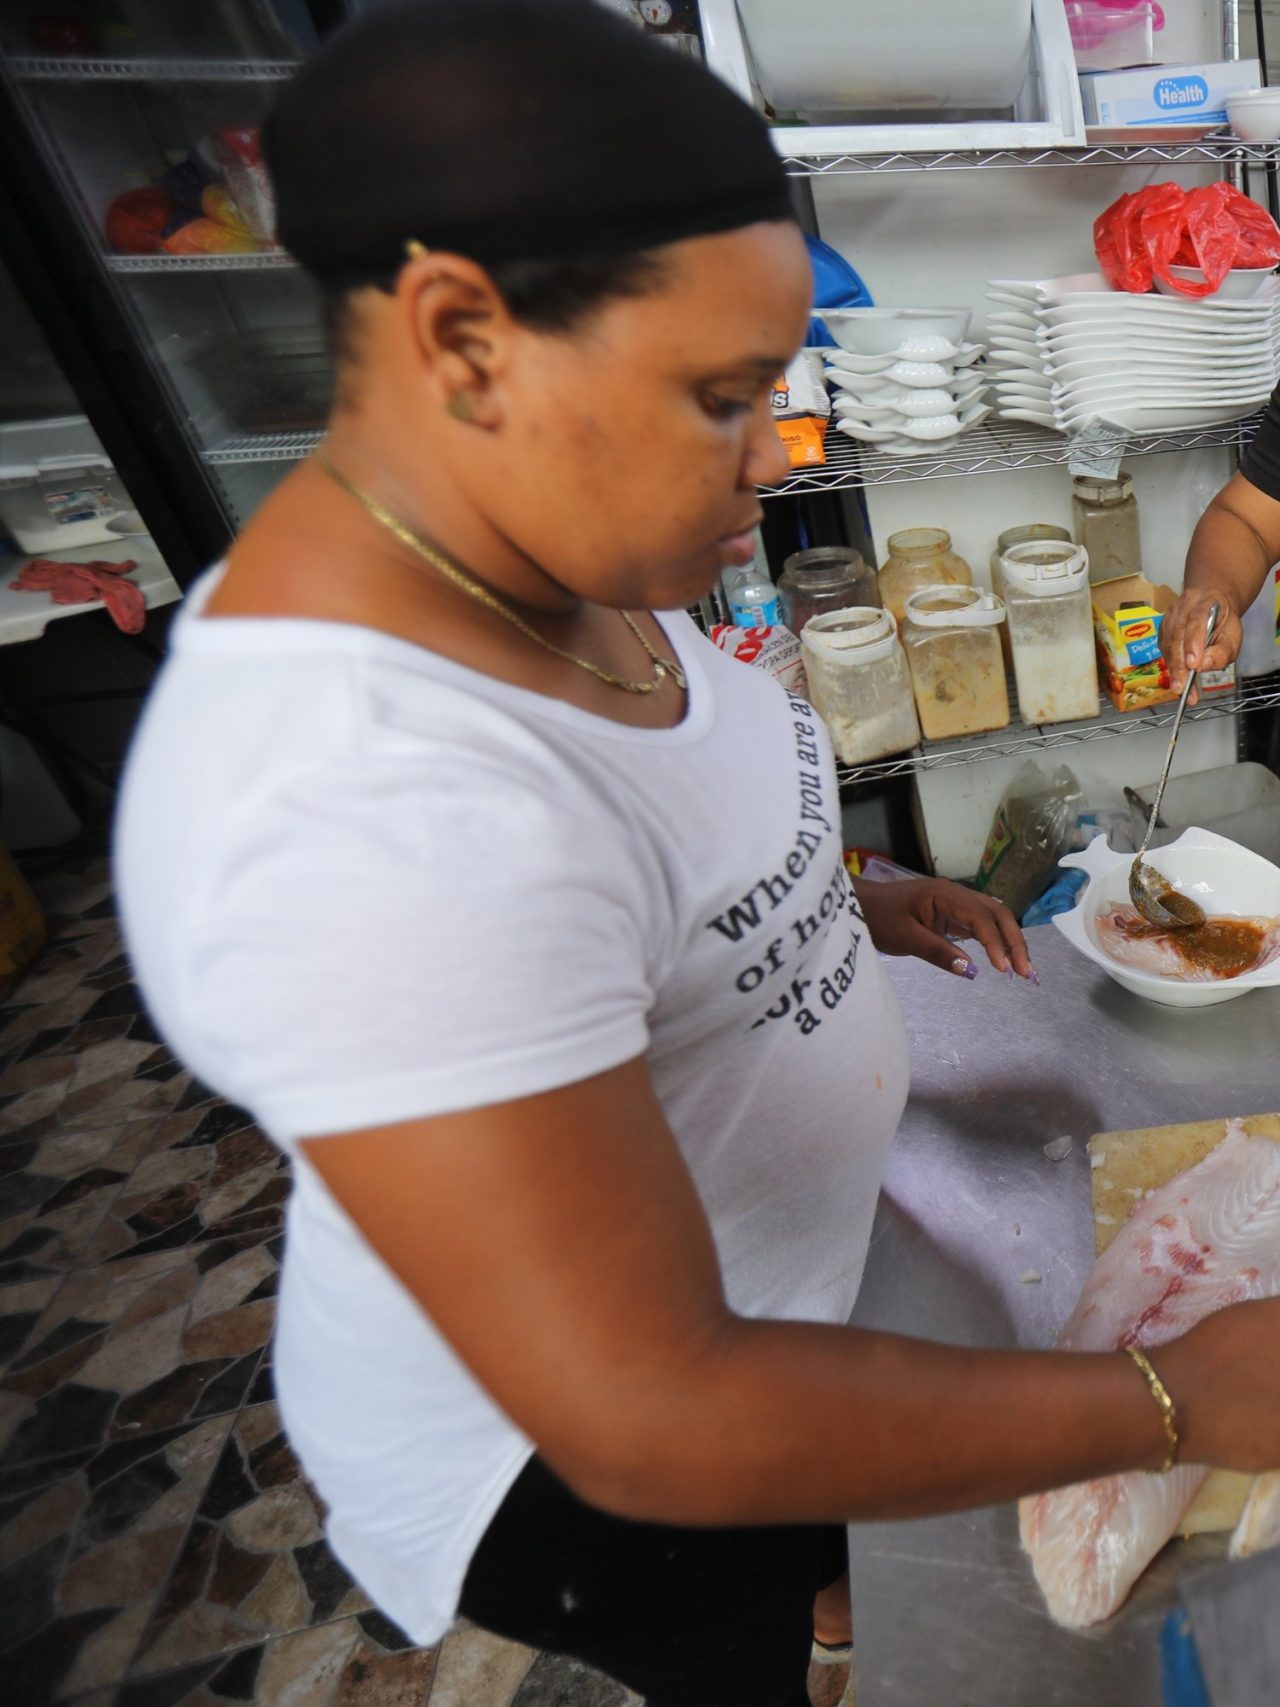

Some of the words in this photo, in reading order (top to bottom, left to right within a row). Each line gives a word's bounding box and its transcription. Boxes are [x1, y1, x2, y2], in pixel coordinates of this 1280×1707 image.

[1159, 84, 1204, 106] Health
[794, 721, 819, 767] are
[799, 770, 832, 832] you
[705, 831, 822, 943] When
[735, 937, 785, 993] of
[794, 1007, 821, 1036] a
